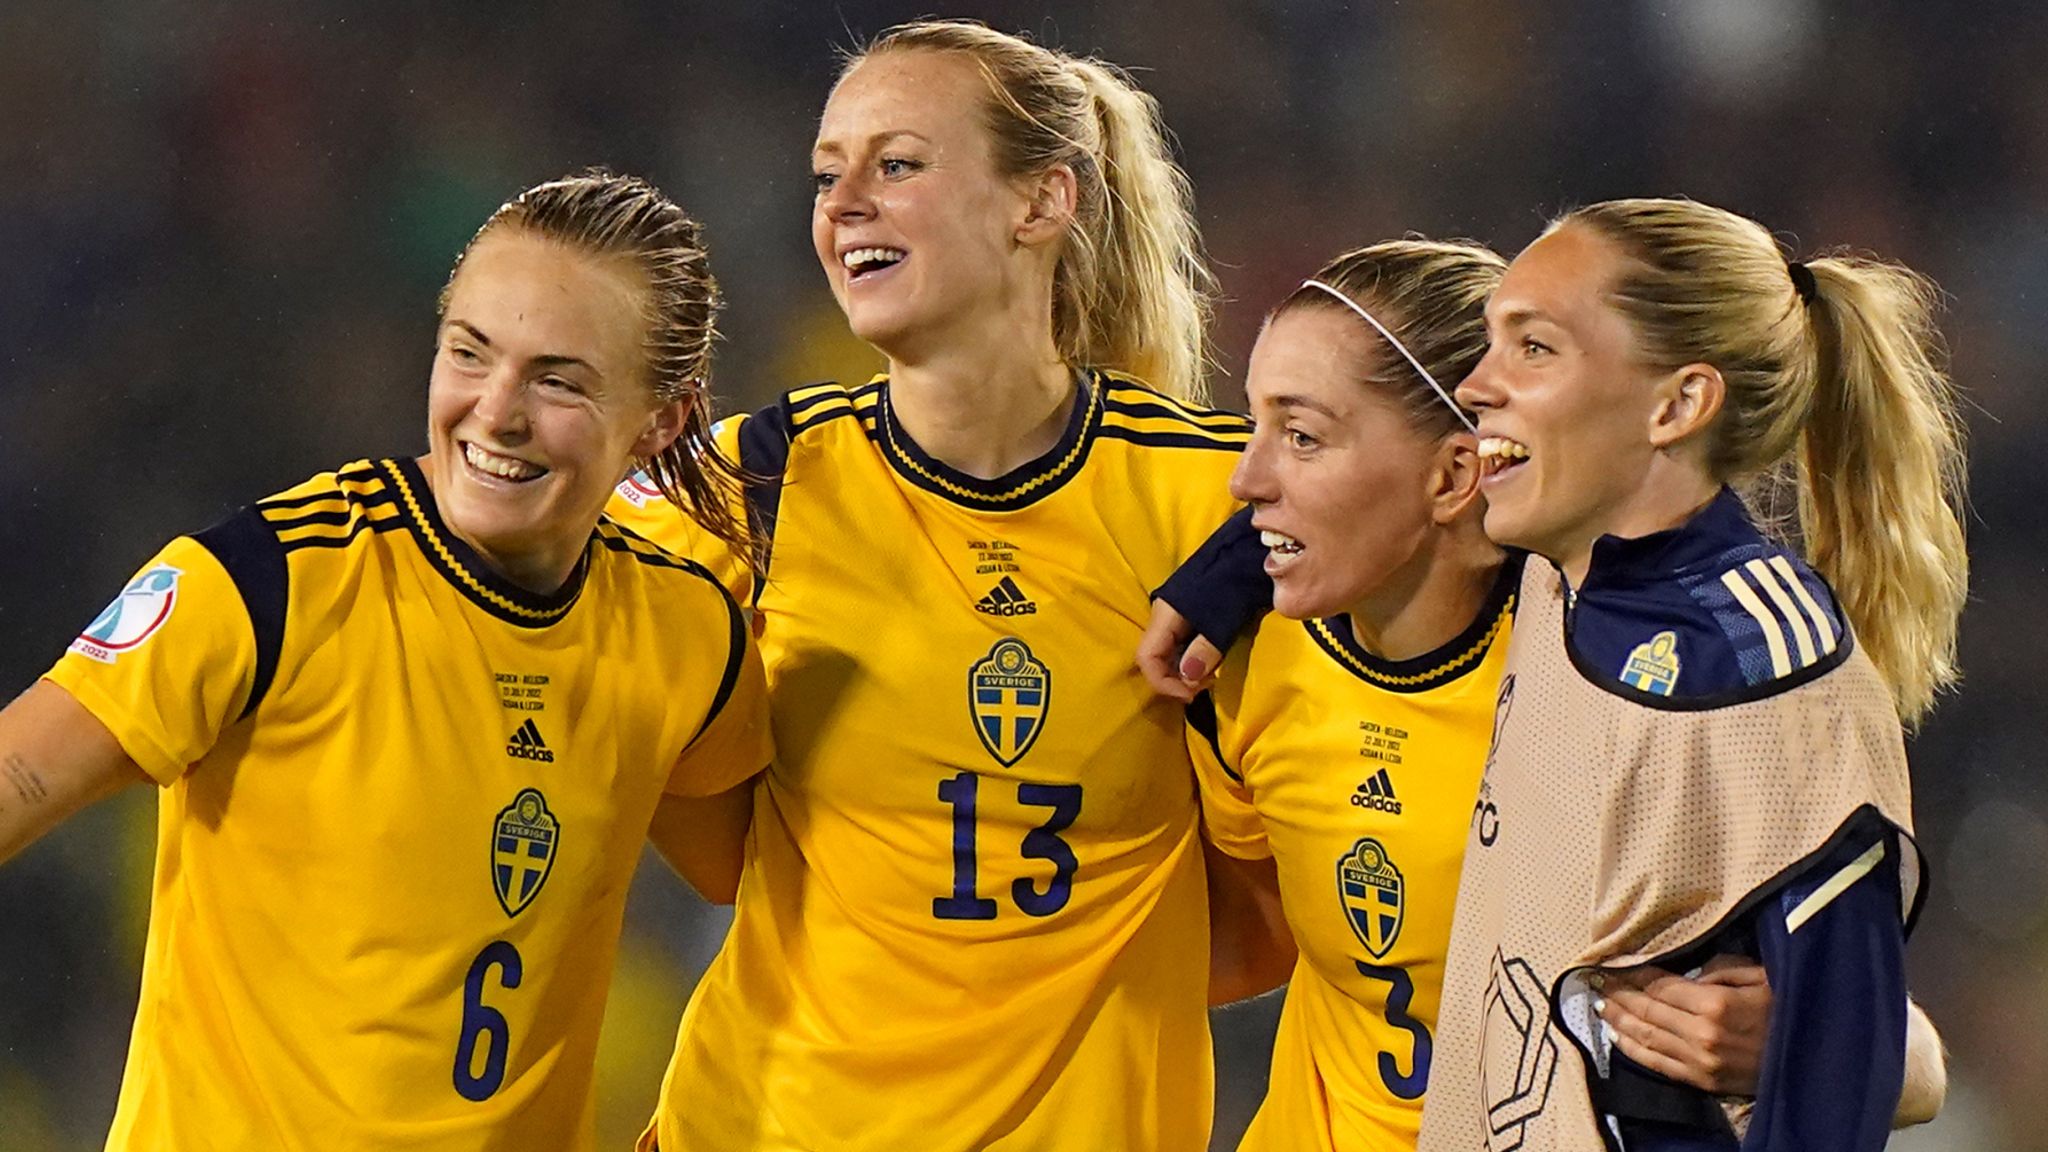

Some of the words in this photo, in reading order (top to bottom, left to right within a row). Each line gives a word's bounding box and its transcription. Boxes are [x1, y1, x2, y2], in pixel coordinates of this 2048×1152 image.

[619, 483, 640, 503] 2022
[974, 601, 1037, 617] adidas
[81, 644, 109, 660] 2022
[984, 676, 1035, 688] SVERIGE
[506, 744, 554, 763] adidas
[1350, 794, 1402, 815] adidas
[505, 824, 546, 840] SVERIGE
[932, 771, 1083, 920] 13
[1349, 870, 1393, 889] SVERIGE
[453, 939, 522, 1102] 6
[1355, 959, 1433, 1101] 3
